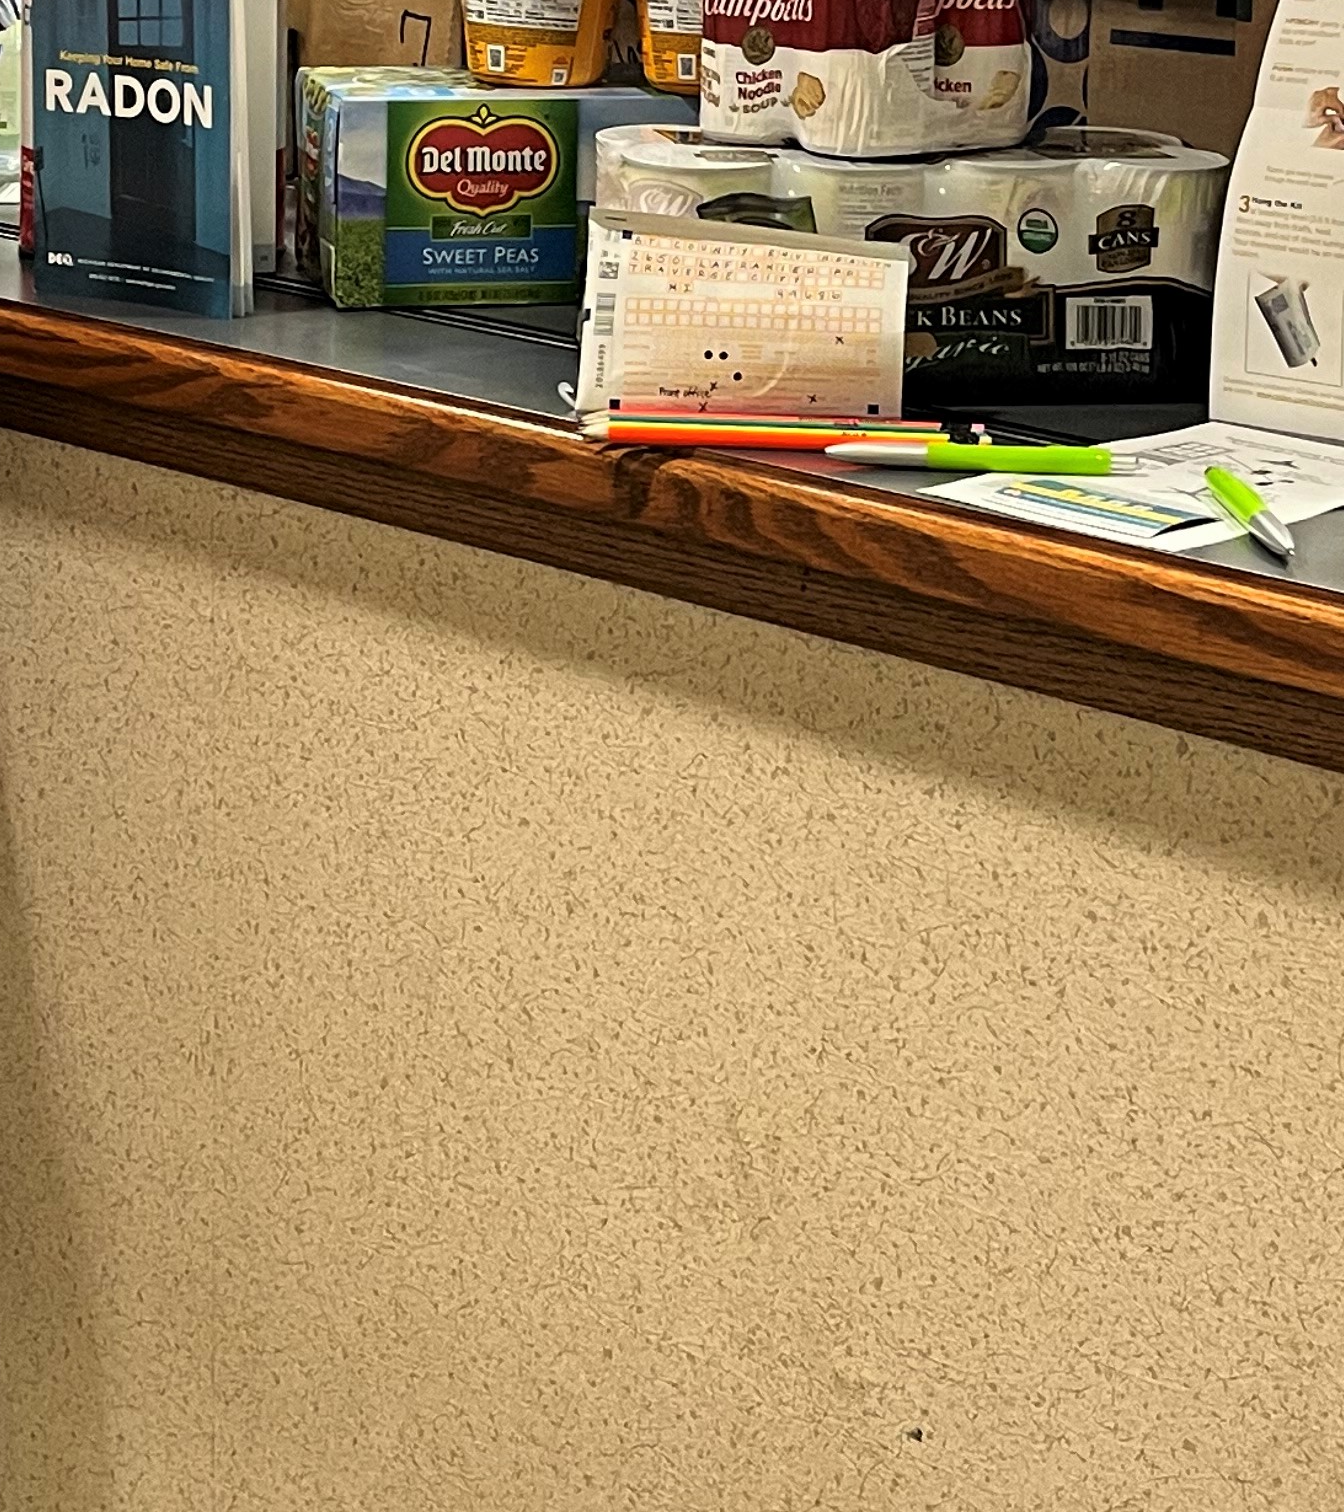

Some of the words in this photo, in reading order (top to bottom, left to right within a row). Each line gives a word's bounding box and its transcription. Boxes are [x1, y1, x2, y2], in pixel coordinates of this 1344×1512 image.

[125, 55, 152, 69] Home
[734, 68, 782, 86] Chicken
[935, 78, 972, 94] icken
[45, 68, 213, 129] RADON
[737, 82, 782, 100] Noodle
[742, 96, 779, 115] SOUP
[422, 145, 462, 174] Del
[466, 145, 547, 174] Monte
[457, 178, 510, 198] Quality
[1238, 195, 1251, 214] 3
[450, 219, 481, 237] Fresh
[483, 222, 507, 236] Cut
[1115, 209, 1138, 228] 8
[1097, 231, 1152, 252] CANS
[422, 247, 487, 266] SWEET
[494, 246, 540, 264] PEAS
[940, 304, 1023, 327] BEANS
